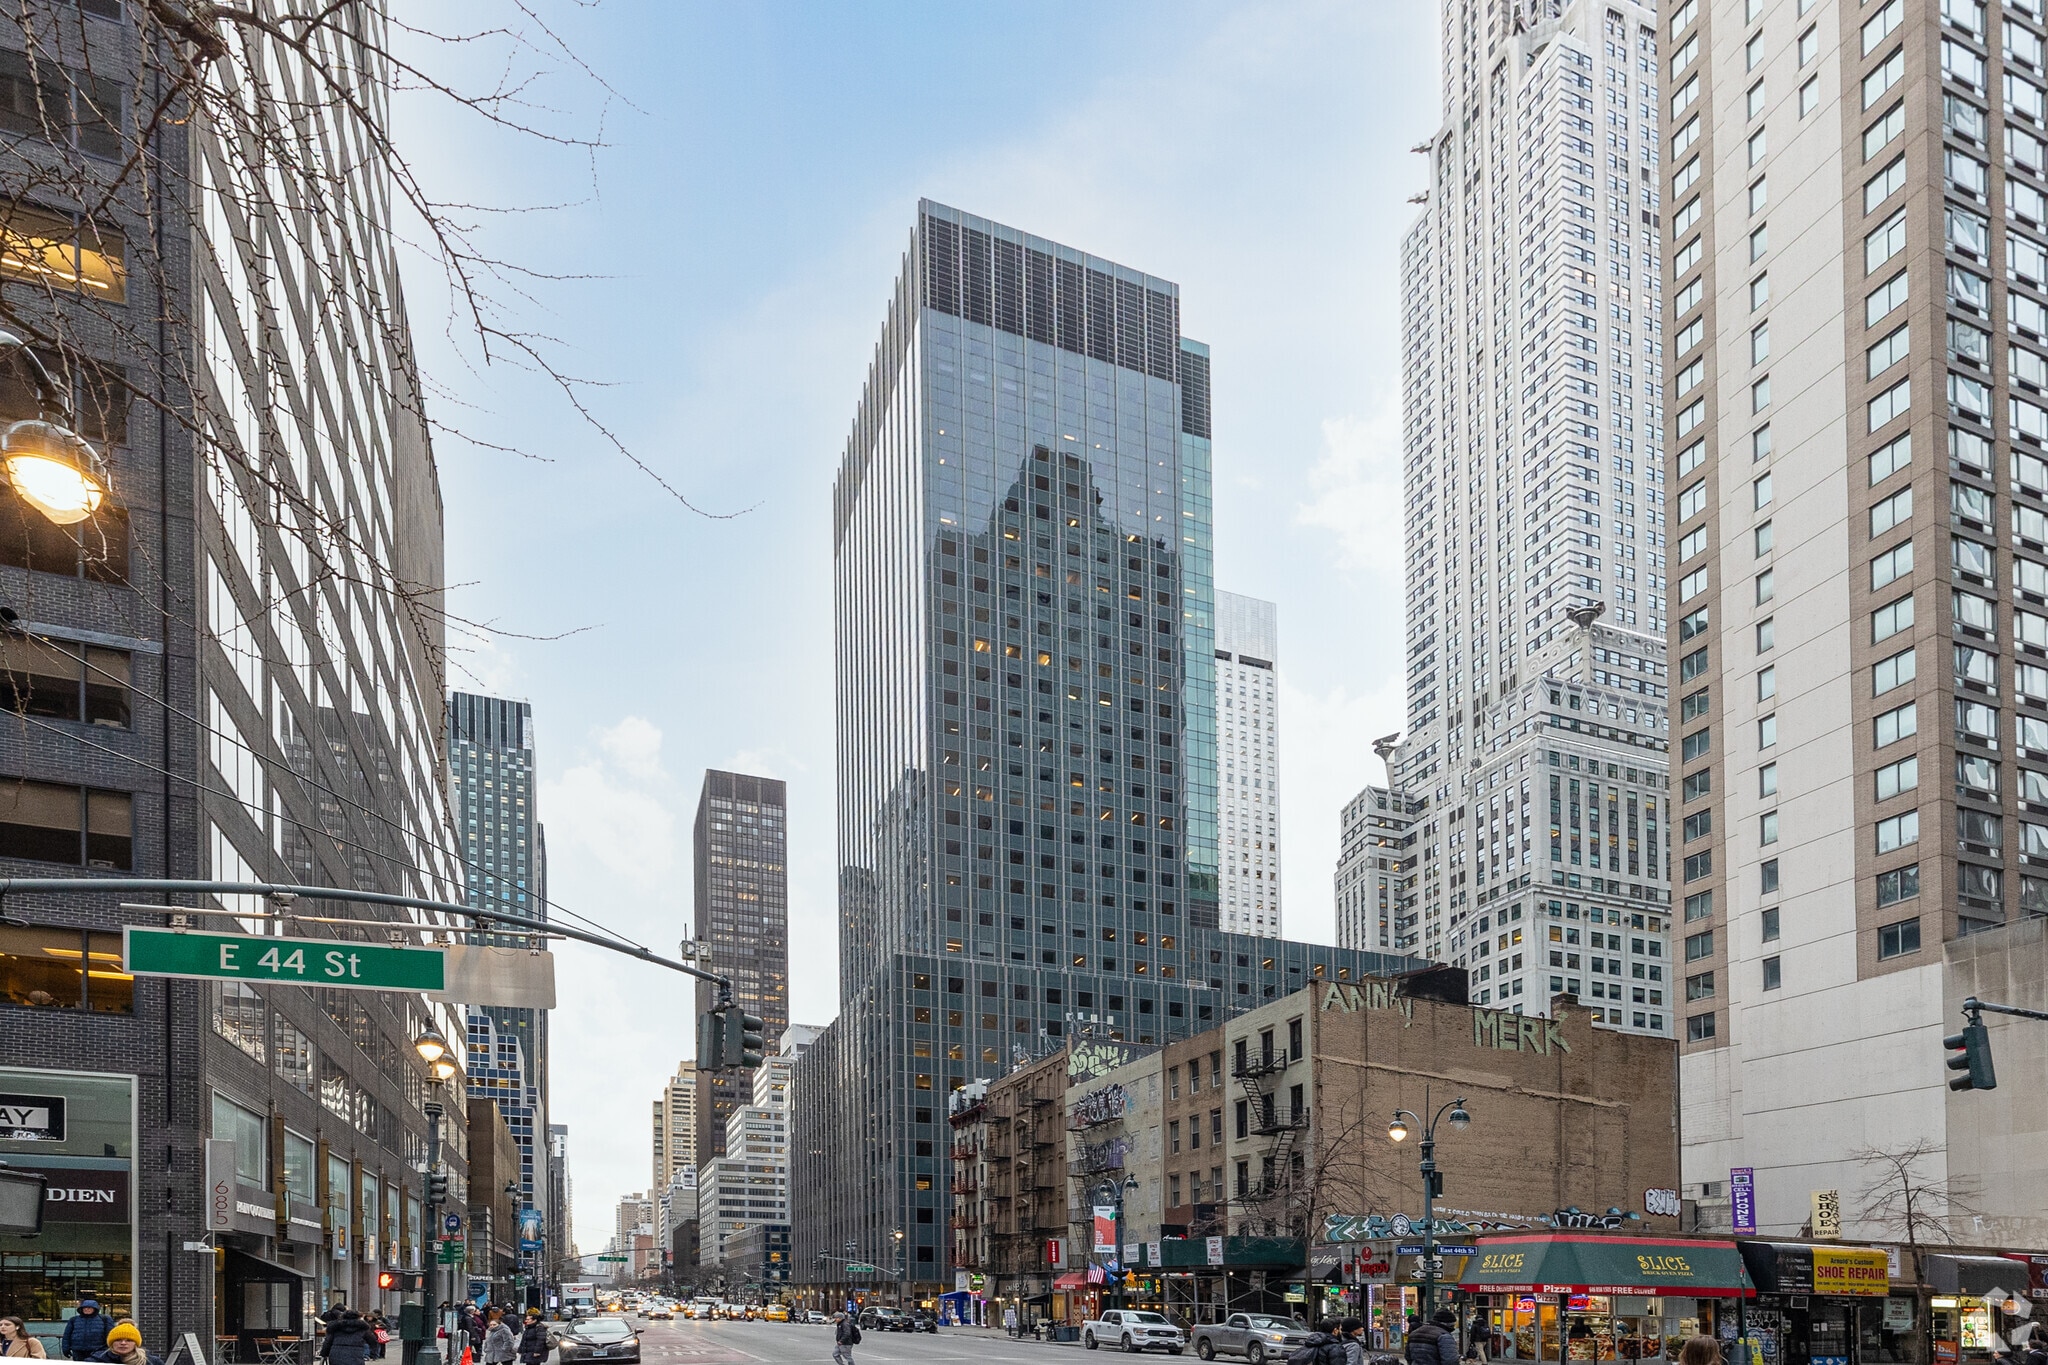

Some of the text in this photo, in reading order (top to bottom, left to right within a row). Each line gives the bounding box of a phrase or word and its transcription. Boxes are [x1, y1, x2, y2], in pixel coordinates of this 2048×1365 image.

[219, 943, 362, 978] E 44 St
[1473, 1007, 1572, 1056] MERK
[215, 1180, 229, 1225] 685
[1735, 1192, 1750, 1227] PHONES
[1818, 1193, 1832, 1227] SHOE
[1482, 1253, 1525, 1269] SLICE
[1637, 1255, 1690, 1271] SLICE
[1817, 1266, 1886, 1280] SHOE REPAIR
[1479, 1284, 1496, 1292] FREE
[1543, 1284, 1573, 1293] Pizza
[1612, 1286, 1633, 1294] FREE
[1517, 1301, 1536, 1309] OPEN
[1536, 1294, 1558, 1302] Pizza
